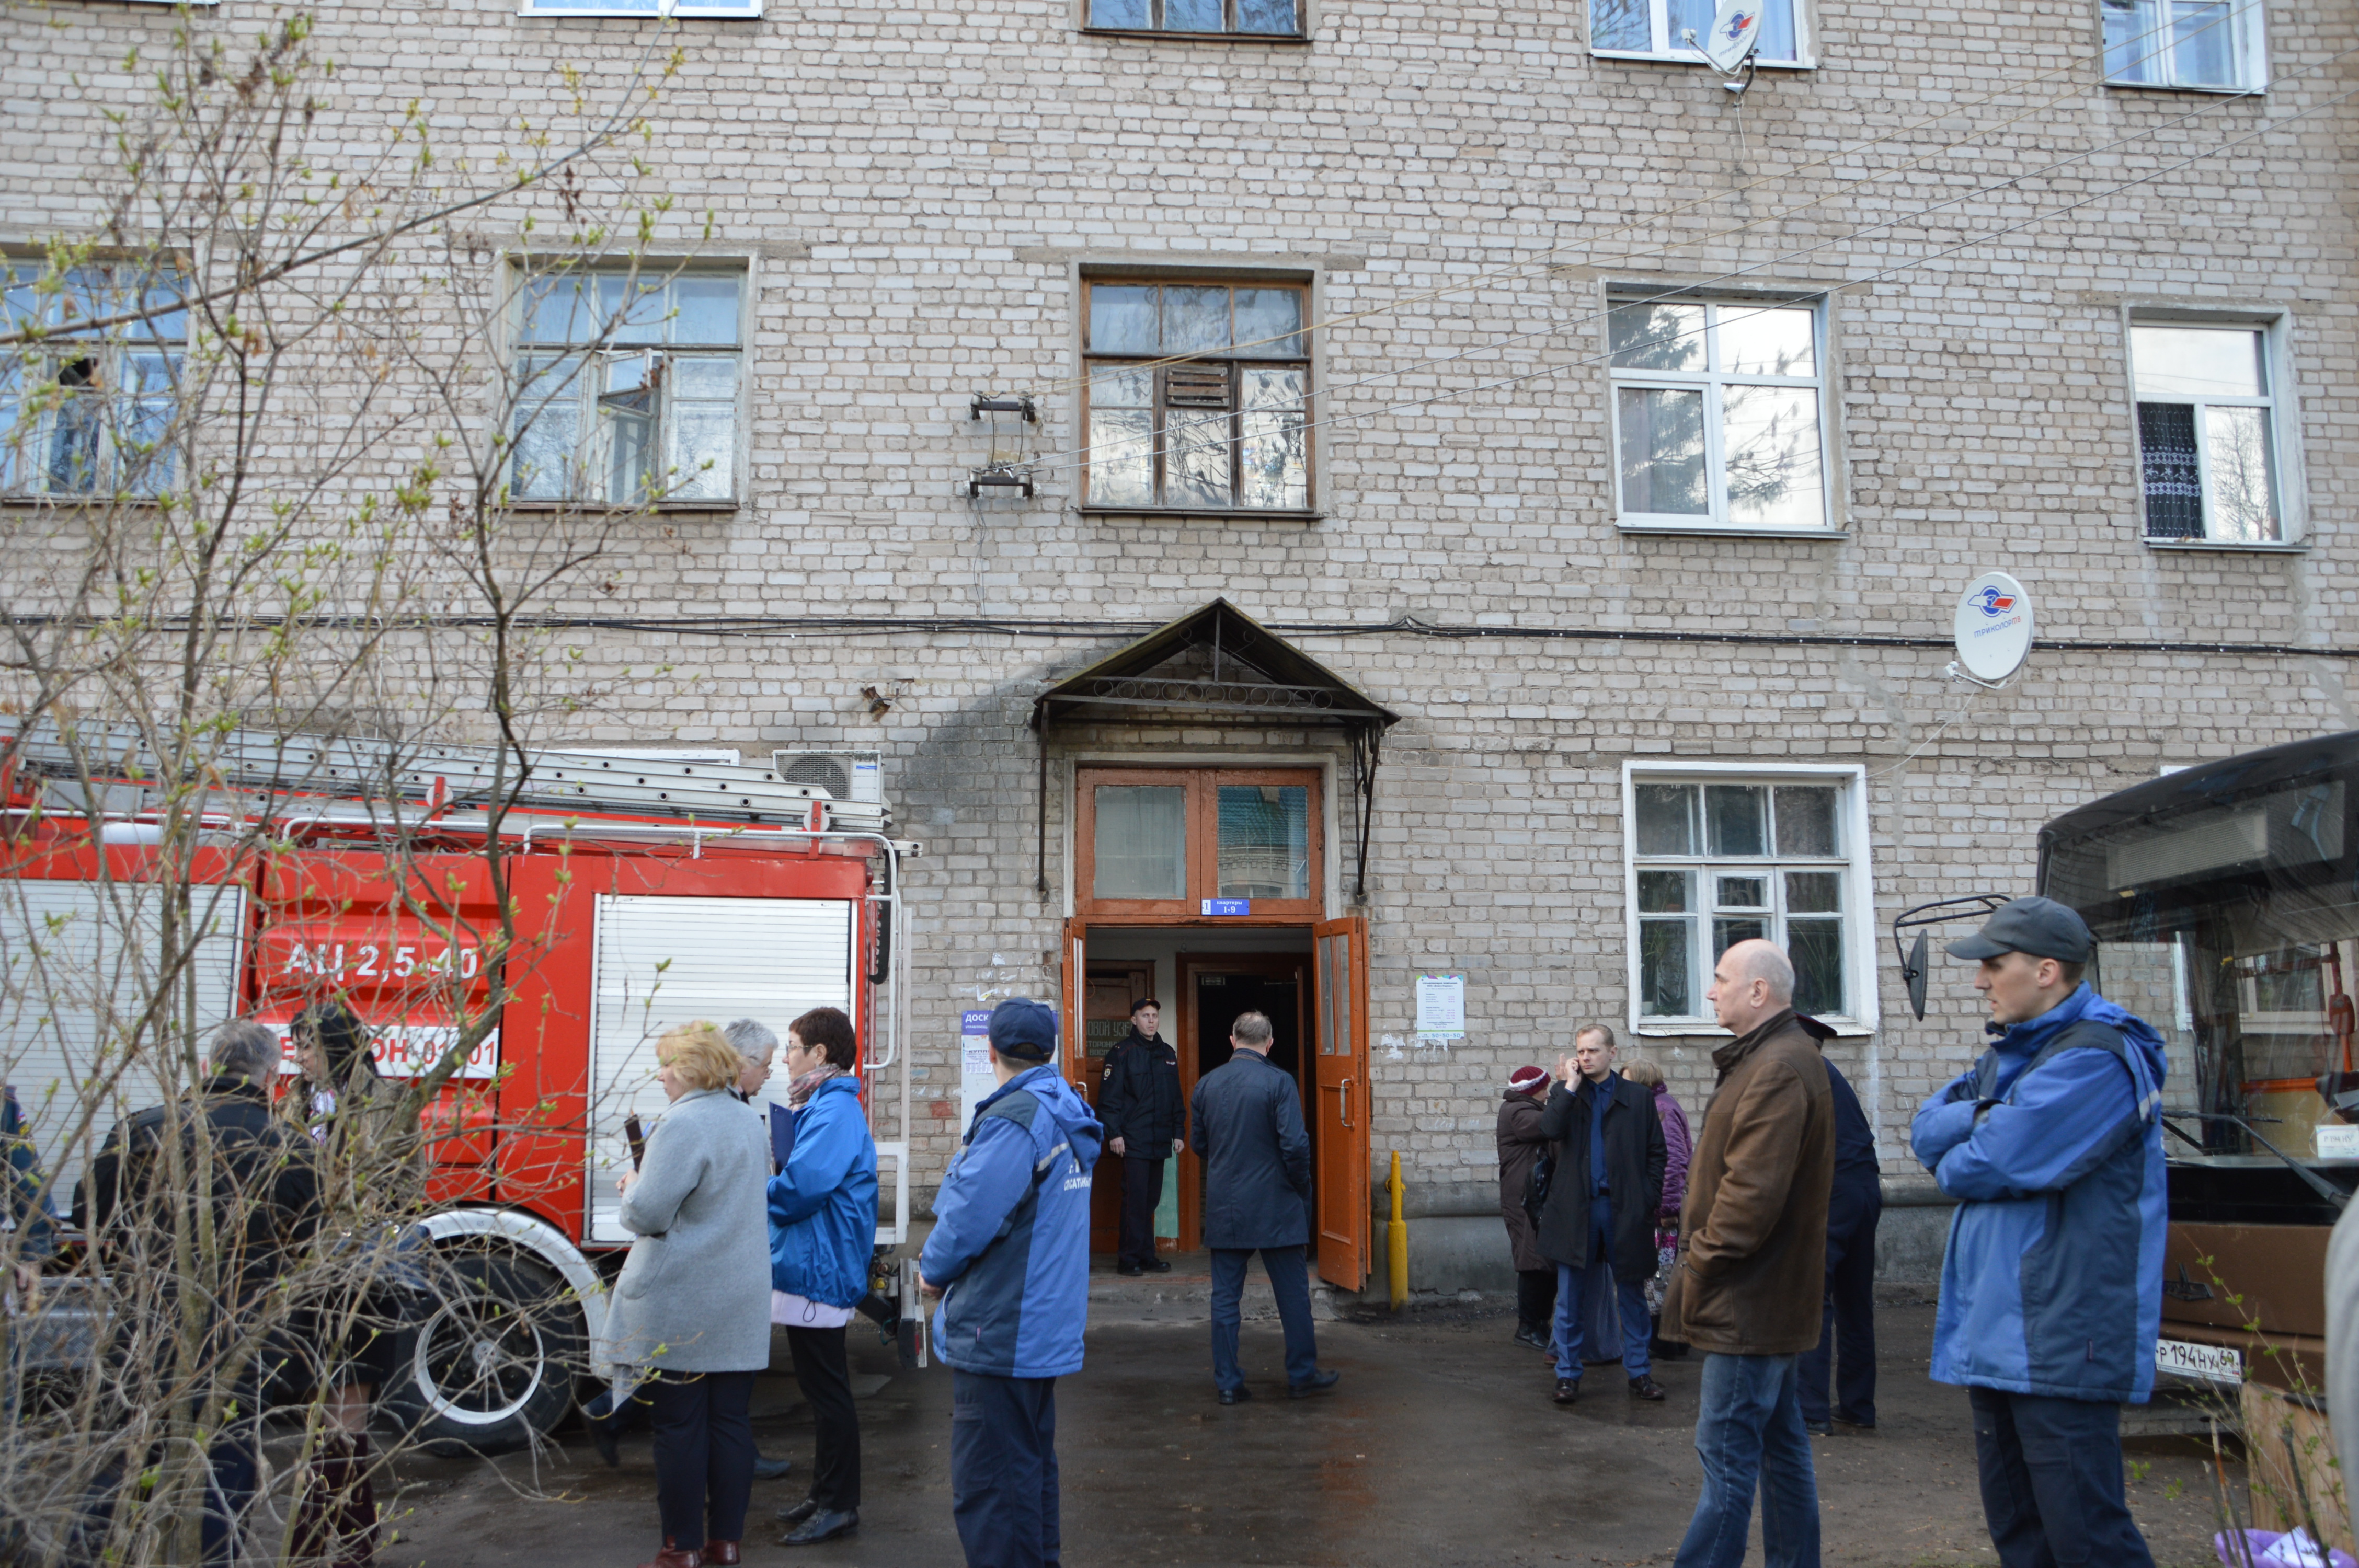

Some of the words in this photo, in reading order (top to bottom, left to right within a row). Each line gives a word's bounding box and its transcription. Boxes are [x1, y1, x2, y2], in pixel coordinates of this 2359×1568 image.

[283, 943, 344, 981] АЦ
[357, 945, 477, 982] 2,5-40
[965, 1014, 989, 1023] ДОСК
[1086, 1020, 1110, 1036] ОВОЙ
